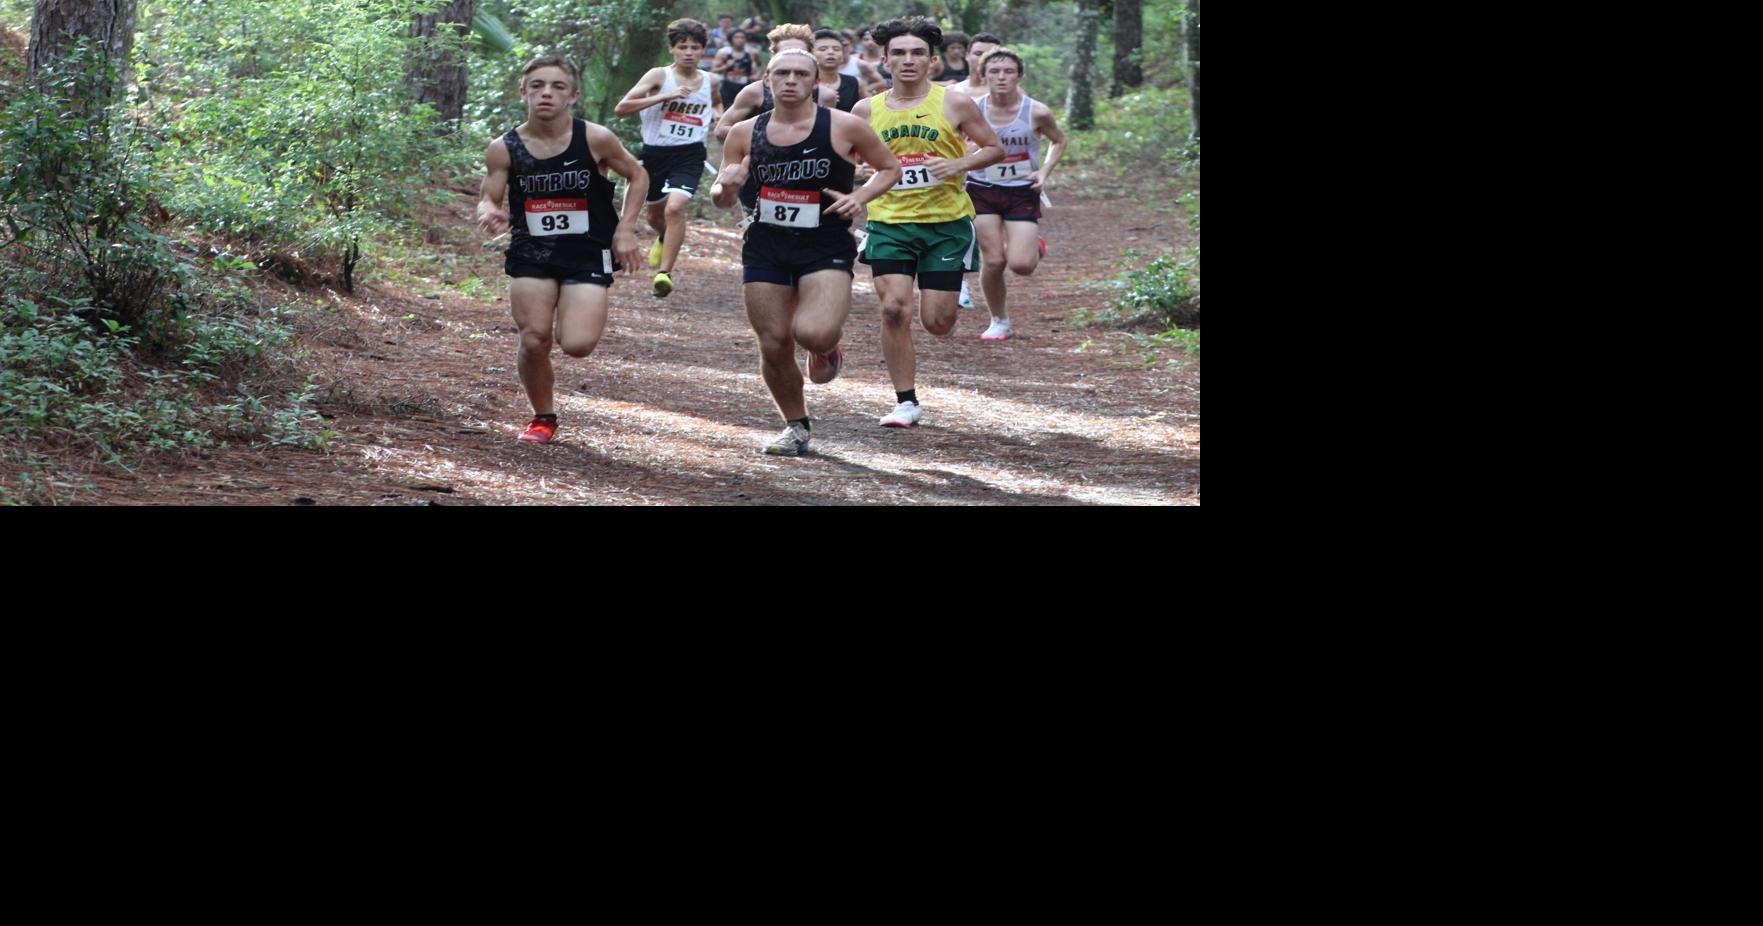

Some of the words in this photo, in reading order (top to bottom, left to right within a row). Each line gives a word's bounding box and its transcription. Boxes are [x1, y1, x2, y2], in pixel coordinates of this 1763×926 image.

[661, 100, 707, 114] FOREST
[670, 124, 694, 138] 151
[881, 124, 939, 142] ECANTO
[757, 158, 831, 182] CITRUS
[997, 165, 1016, 177] 71
[516, 169, 591, 193] CITRUS
[774, 205, 800, 222] 87
[541, 214, 570, 231] 93
